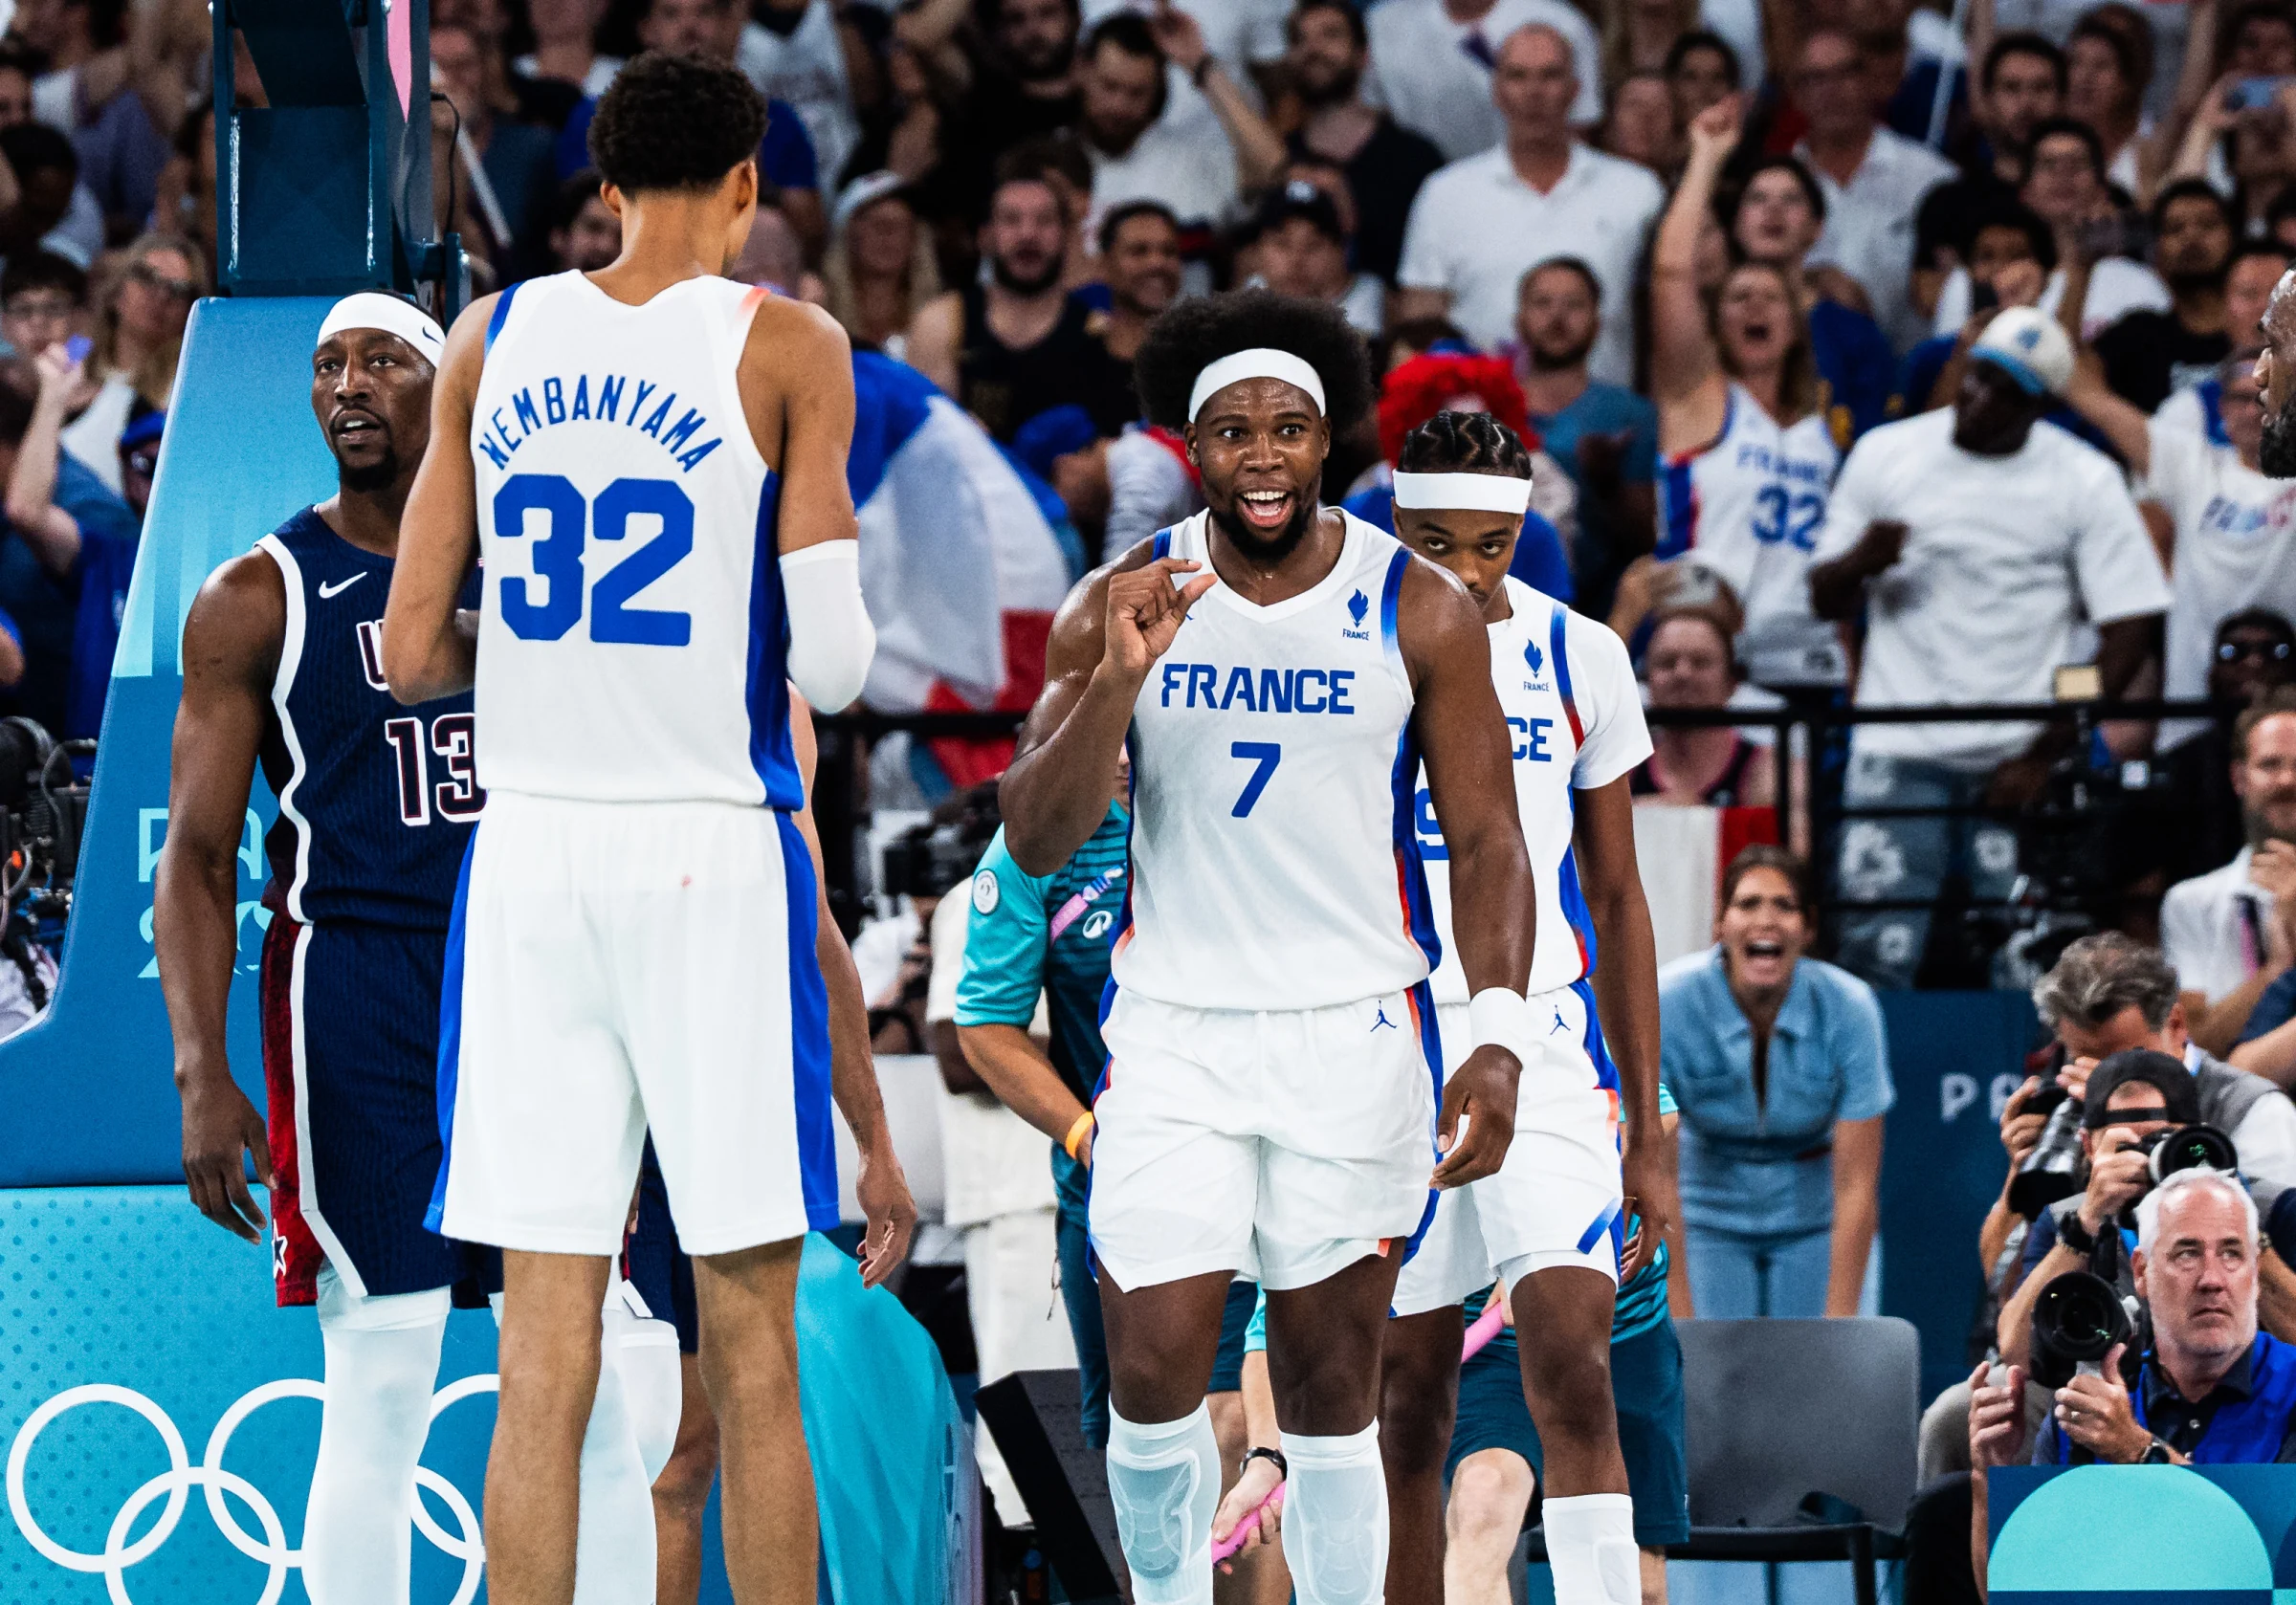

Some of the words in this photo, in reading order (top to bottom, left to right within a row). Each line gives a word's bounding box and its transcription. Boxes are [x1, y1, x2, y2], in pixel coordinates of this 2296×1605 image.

[478, 374, 722, 473] WEMBANYAMA
[1751, 484, 1826, 552] 32
[493, 473, 695, 647] 32
[1342, 628, 1369, 641] FRANCE
[1161, 663, 1355, 715] FRANCE
[1523, 681, 1549, 692] FRANCE
[385, 713, 489, 826] 13
[1231, 741, 1281, 818] 7
